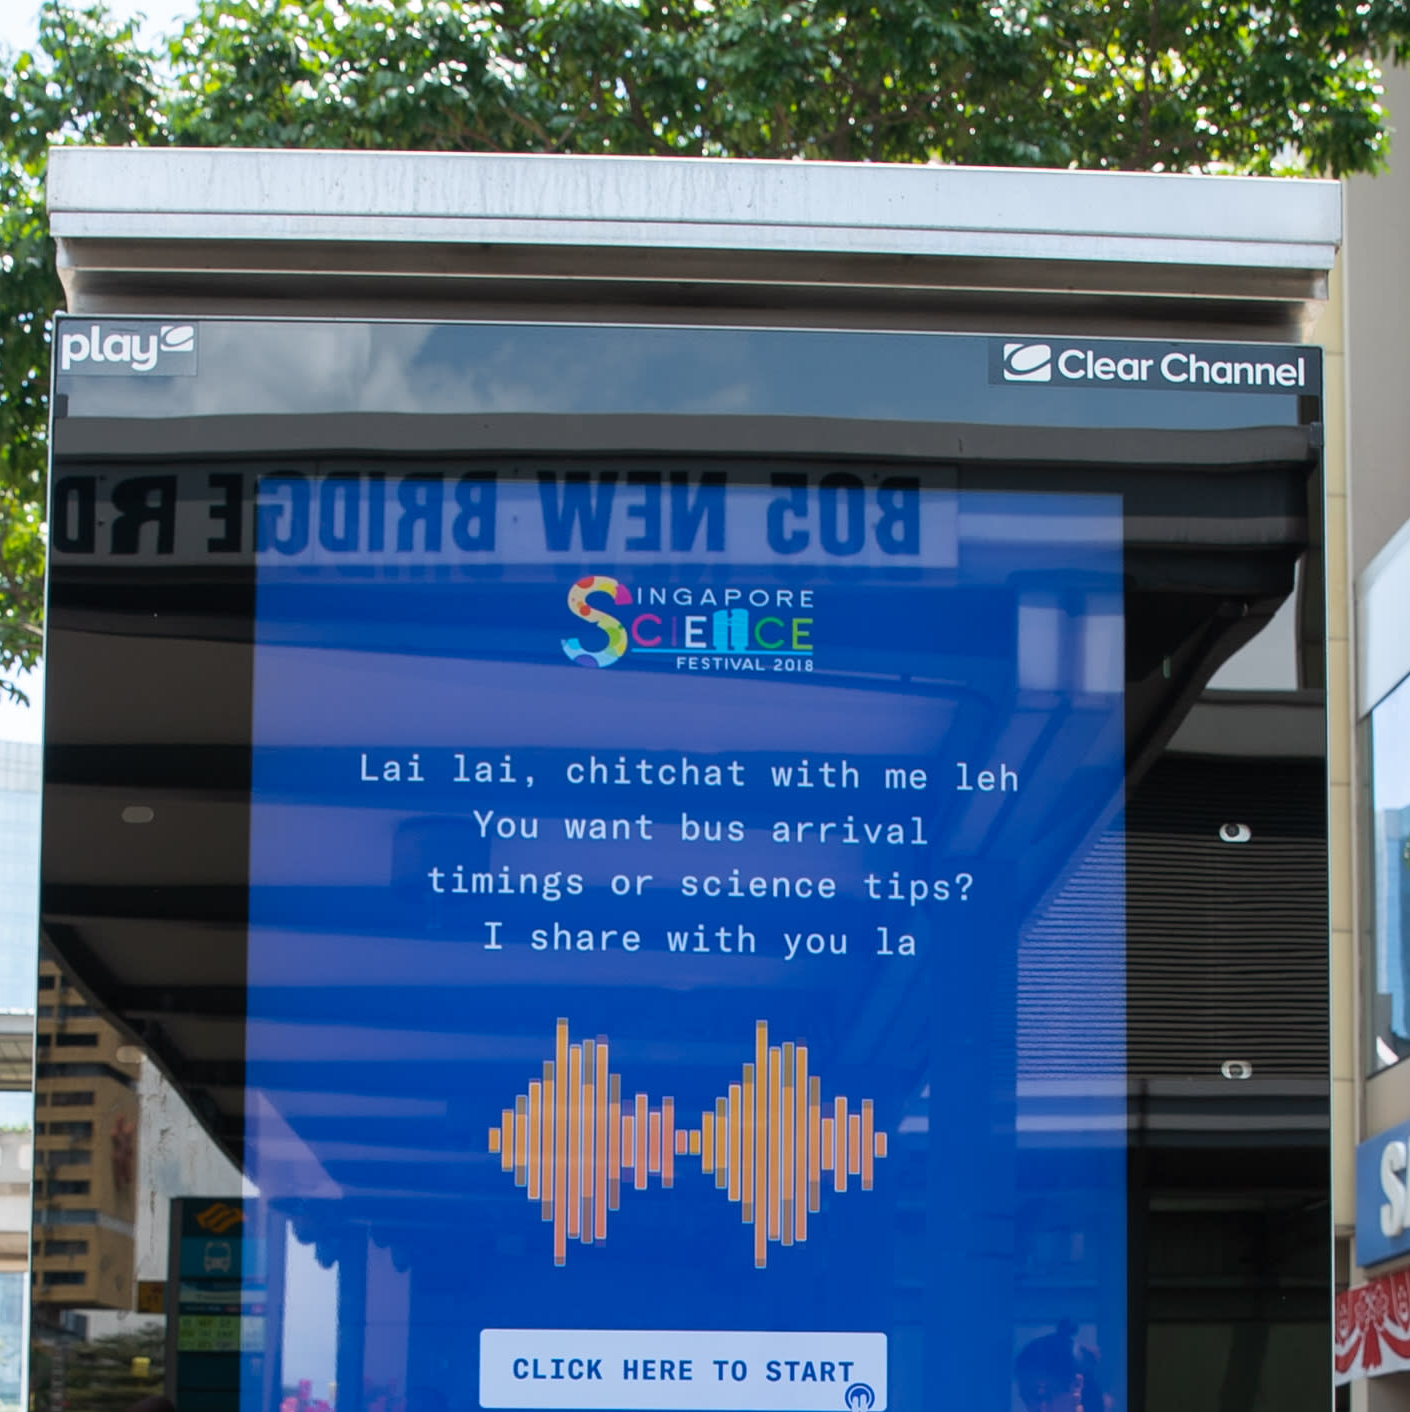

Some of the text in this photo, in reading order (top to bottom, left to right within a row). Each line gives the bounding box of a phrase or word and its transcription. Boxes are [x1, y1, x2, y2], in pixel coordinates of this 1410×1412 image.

[61, 325, 158, 372] play
[1057, 349, 1306, 387] Clear Channel
[676, 656, 815, 672] FESTIVAL 2018
[358, 753, 1020, 793] Lai lai, chitchat with me leh
[473, 810, 929, 846] You want bus arrival
[426, 865, 975, 906] timings or science tips?
[483, 922, 917, 961] I share with you la
[512, 1357, 855, 1384] CLICK HERE TO START
